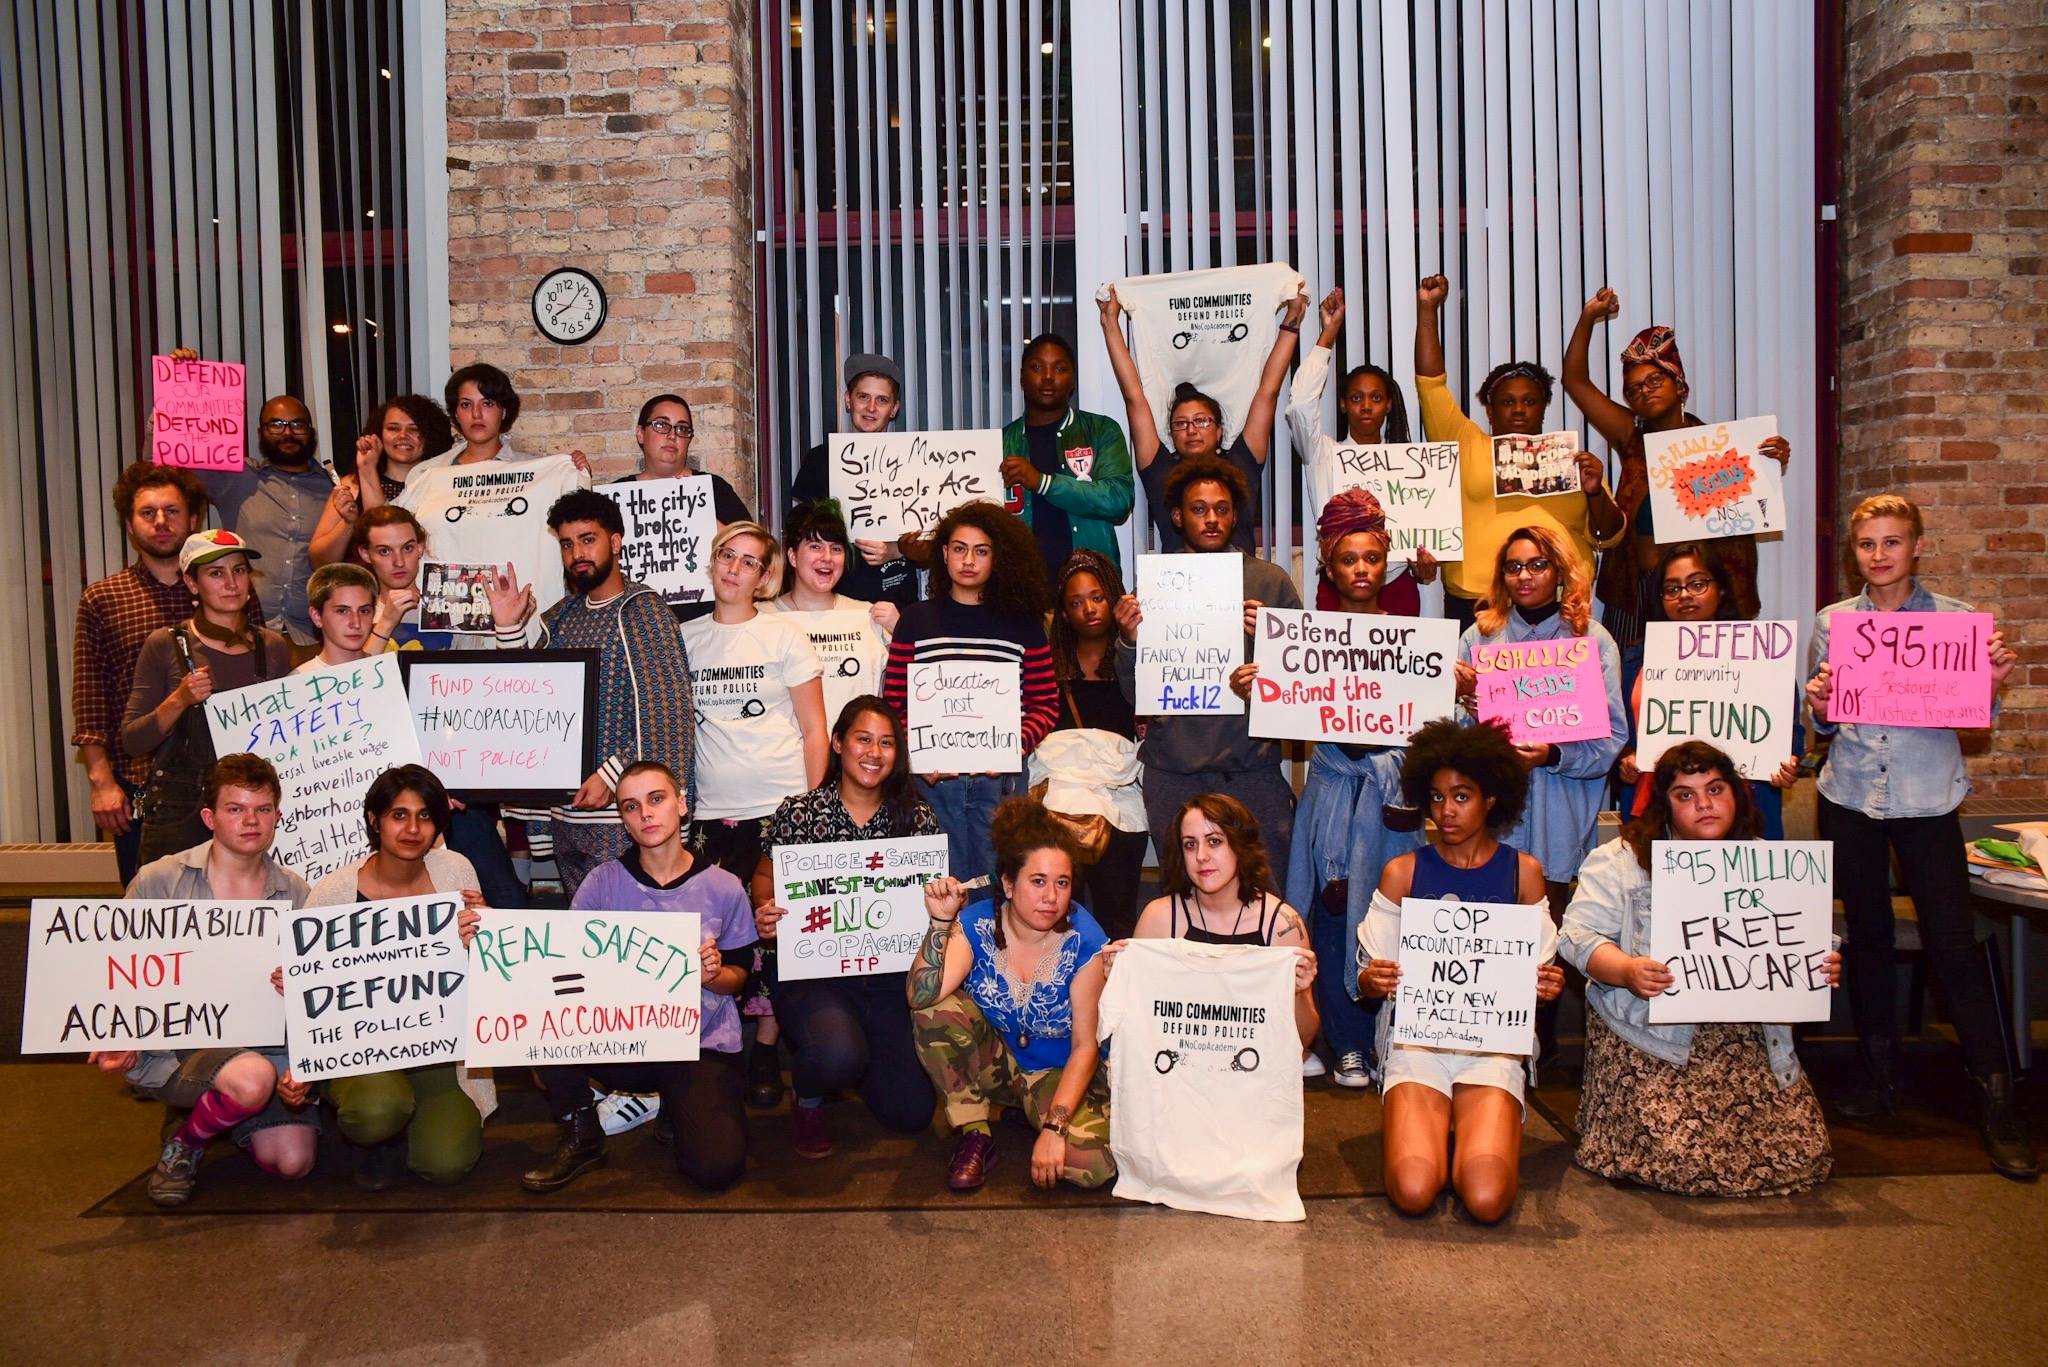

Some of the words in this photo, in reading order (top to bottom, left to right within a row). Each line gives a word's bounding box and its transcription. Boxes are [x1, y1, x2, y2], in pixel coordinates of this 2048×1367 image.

[547, 292, 557, 302] 10
[556, 283, 562, 293] 11
[563, 280, 573, 289] 12
[583, 287, 590, 297] 2
[545, 304, 553, 314] 9
[587, 300, 594, 310] 3
[1169, 298, 1191, 310] FUND
[1193, 294, 1252, 309] COMMUNITIES
[551, 316, 558, 326] 8
[561, 322, 567, 333] 7
[577, 321, 584, 331] 5
[584, 312, 591, 321] 4
[1178, 312, 1210, 321] DEFUND
[1215, 309, 1244, 319] POLICE
[568, 324, 576, 334] 6
[157, 359, 241, 388] DEFEND
[172, 384, 210, 398] OUR
[154, 397, 244, 417] COMMUNITIES
[156, 412, 238, 435] DEFUND
[157, 441, 241, 465] POLICE
[841, 442, 903, 481] Silly
[908, 436, 976, 469] Mayor
[1337, 449, 1404, 475] REAL
[1404, 444, 1459, 488] SAFETY
[453, 475, 474, 489] FUND
[476, 472, 535, 487] COMMUNITIES
[458, 489, 491, 498] DEFUND
[495, 484, 525, 496] POLICE
[848, 478, 930, 501] Schools
[939, 469, 986, 496] Are
[626, 489, 657, 516] the
[662, 485, 707, 518] city's
[1387, 480, 1435, 509] Money
[851, 505, 888, 529] For
[901, 497, 955, 530] Kid
[1717, 501, 1744, 521] NOT
[634, 511, 688, 545] broke,
[1389, 527, 1463, 552] UNITIES
[806, 631, 862, 644] MMUNITIES
[1165, 623, 1205, 642] NOT
[1266, 612, 1352, 646] Defend
[1369, 628, 1416, 646] our
[1678, 622, 1793, 661] DEFEND
[822, 643, 855, 652] POLICE
[1141, 646, 1188, 664] FANCY
[1196, 648, 1231, 664] NEW
[429, 673, 473, 698] FUND
[482, 675, 554, 698] SCHOOLS
[701, 665, 765, 682] COMMUNITIES
[913, 664, 1010, 701] Education
[1162, 665, 1226, 683] FACILITY
[1645, 667, 1668, 681] our
[1675, 663, 1740, 694] community
[690, 685, 717, 696] EFUND
[723, 682, 758, 694] POLICE
[1256, 676, 1335, 705] Defund
[1343, 675, 1382, 701] the
[213, 682, 295, 731] What
[943, 692, 975, 715] not
[1525, 704, 1583, 728] COPS
[246, 698, 366, 753] SAFETY
[418, 706, 576, 742] #NOCOPACADEMY
[1319, 702, 1413, 735] Police!!
[1646, 697, 1771, 744] DEFUND
[911, 725, 1019, 755] Incarceration
[312, 748, 354, 770] liveable
[359, 741, 389, 756] wage
[427, 748, 467, 770] NOT
[479, 748, 549, 777] POLICE!
[780, 850, 863, 877] POLICE
[886, 848, 948, 869] SAFETY
[1662, 846, 1716, 885] $95
[1722, 845, 1827, 886] MILLION
[784, 876, 863, 900] INVEST
[1724, 888, 1776, 916] FOR
[801, 896, 892, 934] #NO
[1433, 906, 1490, 934] COP
[292, 901, 457, 957] DEFEND
[1682, 911, 1806, 950] FREE
[473, 922, 566, 982] REAL
[582, 919, 698, 993] SAFETY
[794, 933, 925, 959] COPACADE
[1400, 934, 1535, 957] ACCOUNTABILITY
[107, 950, 194, 991] NOT
[288, 960, 324, 977] OUR
[332, 941, 451, 970] COMMUNITIES
[840, 956, 879, 973] FTP
[1663, 950, 1829, 997] CHILDCARE
[303, 970, 465, 1020] DEFUND
[1403, 985, 1455, 1006] FANCY
[1463, 991, 1498, 1008] NEW
[60, 1001, 230, 1043] ACADEMY
[308, 1026, 344, 1045] THE
[354, 1004, 445, 1039] POLICE!
[476, 1013, 527, 1044] COP
[540, 1003, 700, 1041] ACCOUNTABILITY
[1154, 1000, 1183, 1018] FUND
[1186, 1002, 1266, 1024] COMMUNITIES
[1416, 1007, 1528, 1027] FACILITY!!!
[1163, 1021, 1207, 1036] DEFUND
[1215, 1025, 1255, 1039] POLICE
[297, 1037, 458, 1074] #NOCOPACADEMY
[525, 1040, 648, 1060] #NOCOPACADEMY
[1179, 1039, 1238, 1053] #NoCopAcademy
